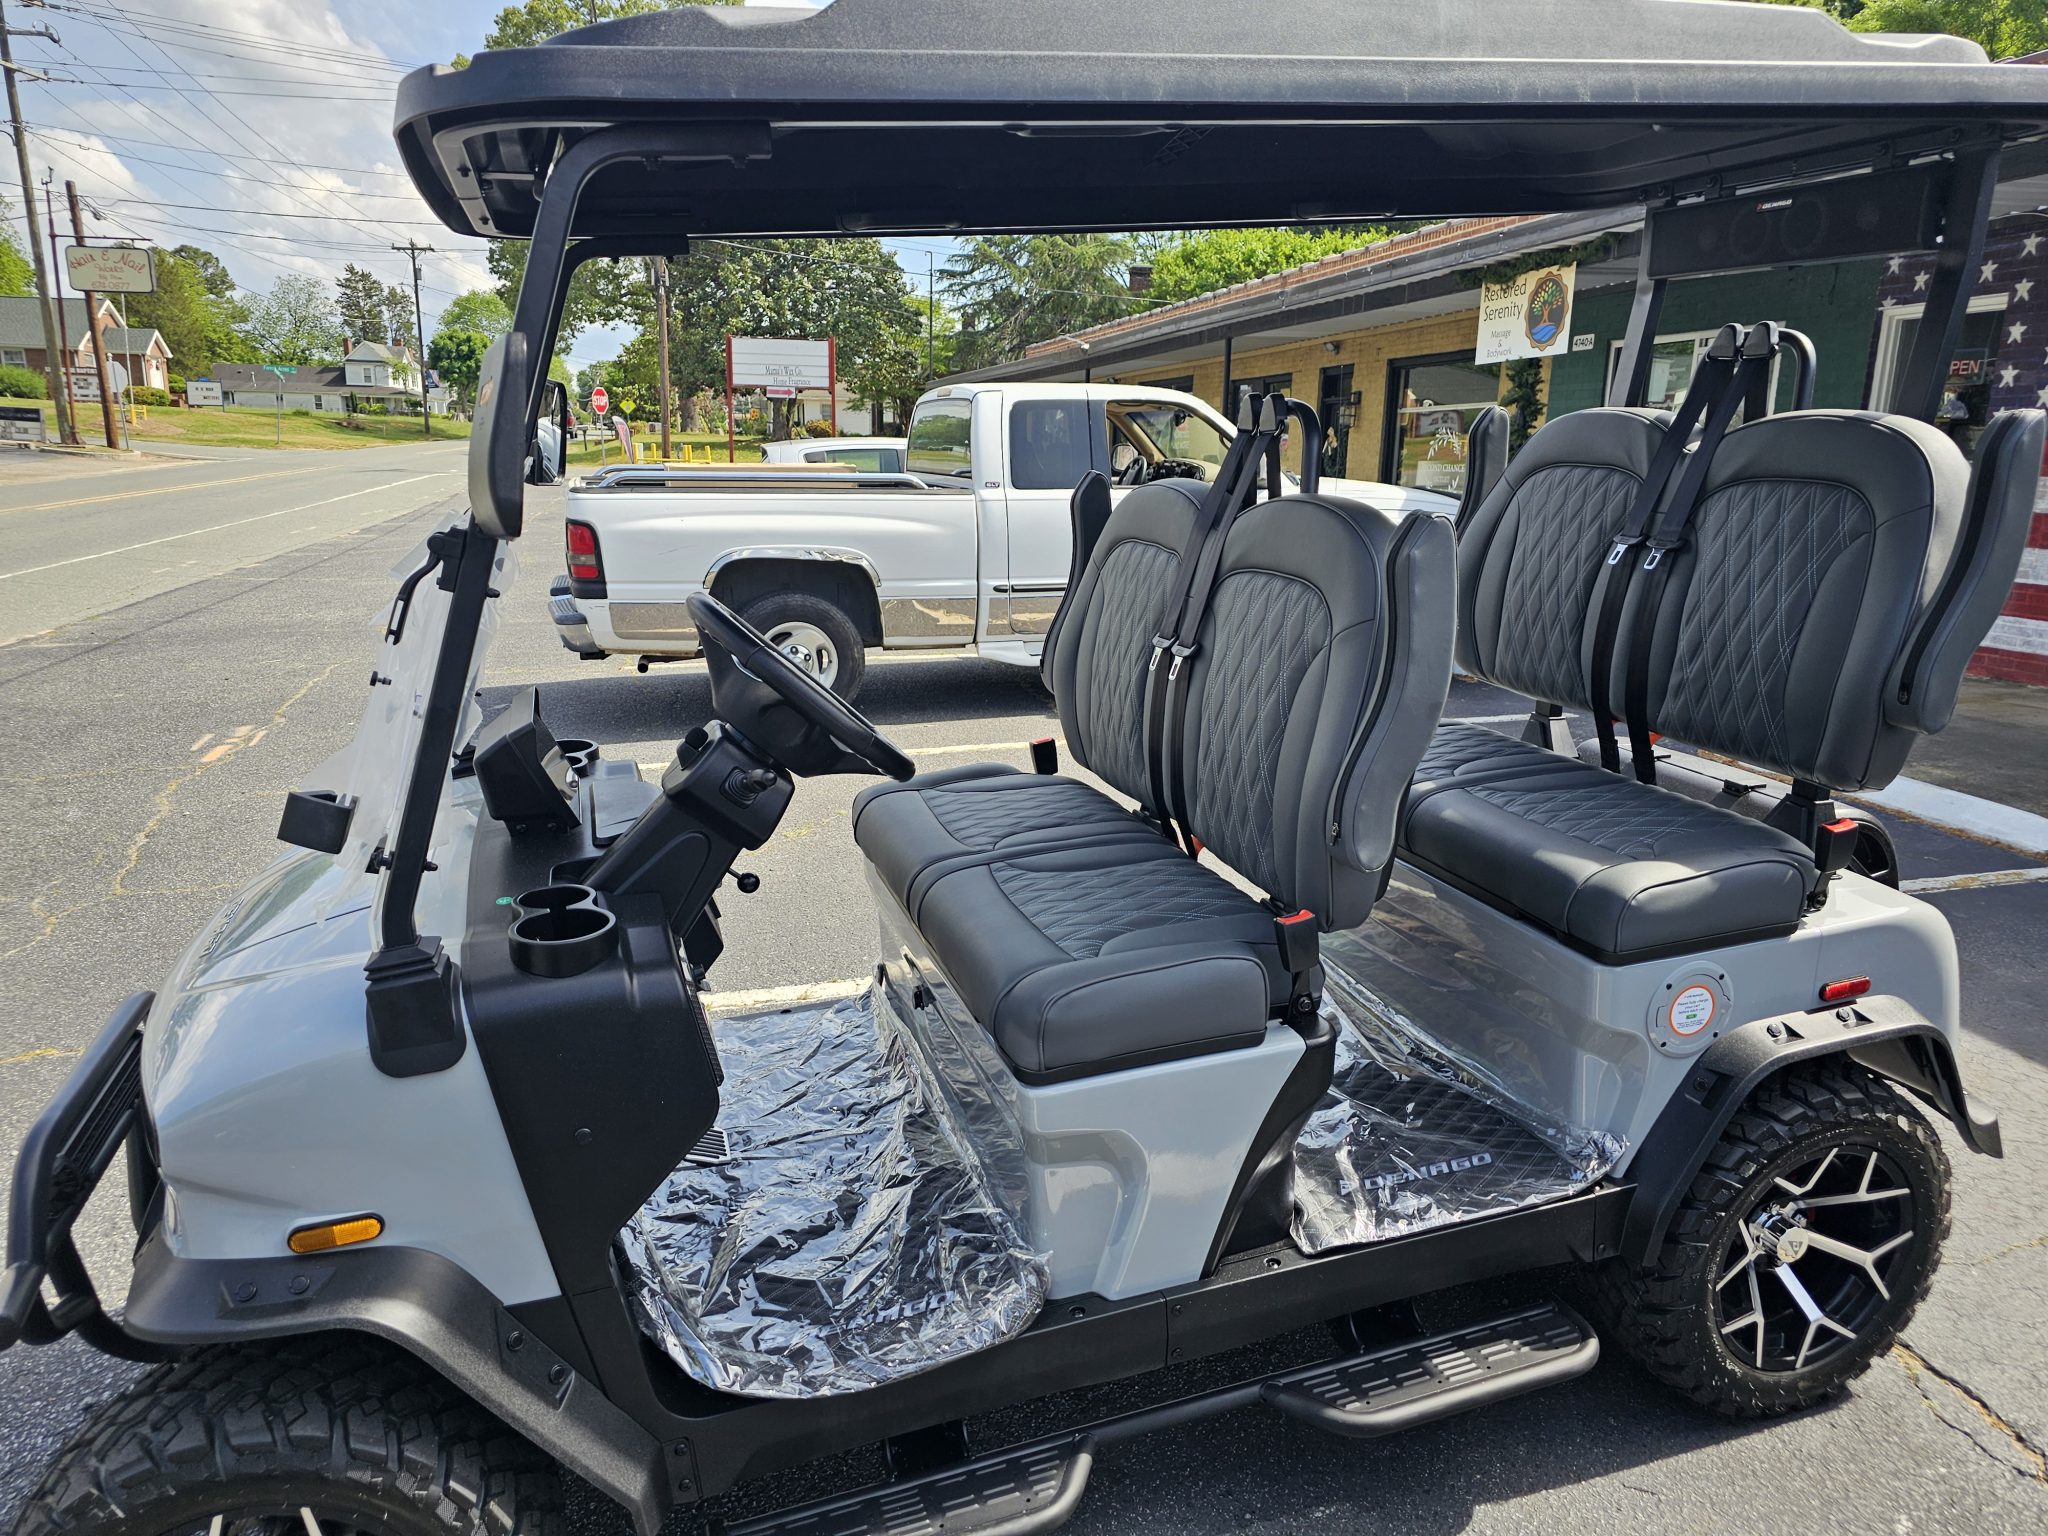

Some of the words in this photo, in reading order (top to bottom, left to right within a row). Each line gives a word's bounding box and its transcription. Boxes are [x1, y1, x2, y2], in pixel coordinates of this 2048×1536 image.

[70, 253, 96, 270] Hair
[113, 253, 146, 273] Nail
[1484, 278, 1527, 302] Restored
[1484, 302, 1523, 322] Serenity
[1491, 329, 1511, 339] Massage
[1487, 349, 1512, 359] Bodywork
[1950, 360, 1980, 375] PEN
[594, 396, 608, 406] STOP
